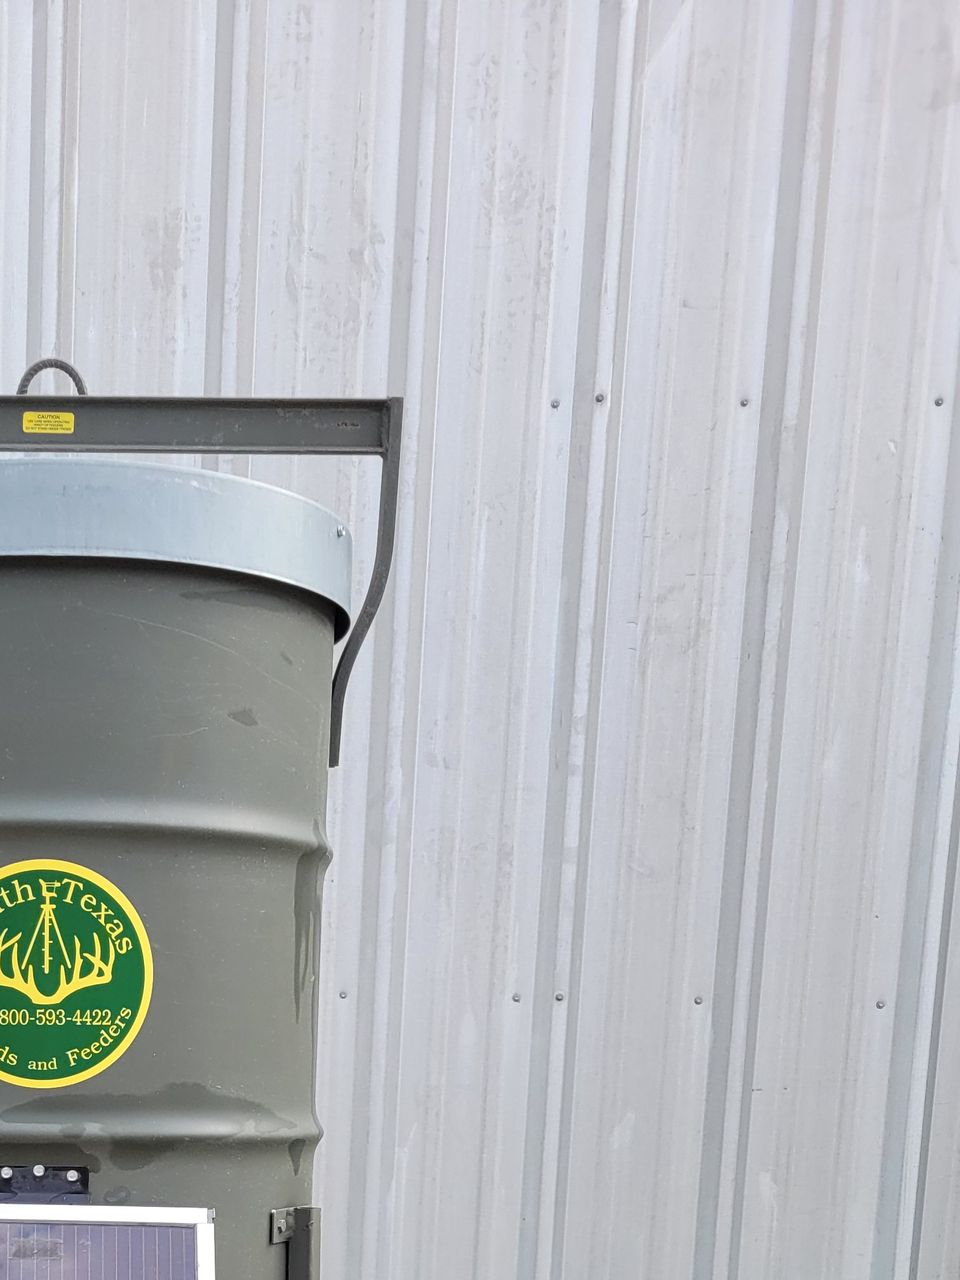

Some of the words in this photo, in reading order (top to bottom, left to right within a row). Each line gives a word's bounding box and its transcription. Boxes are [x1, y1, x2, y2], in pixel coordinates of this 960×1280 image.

[61, 878, 133, 955] Texas
[27, 1057, 58, 1071] and
[65, 1006, 133, 1067] Feeders
